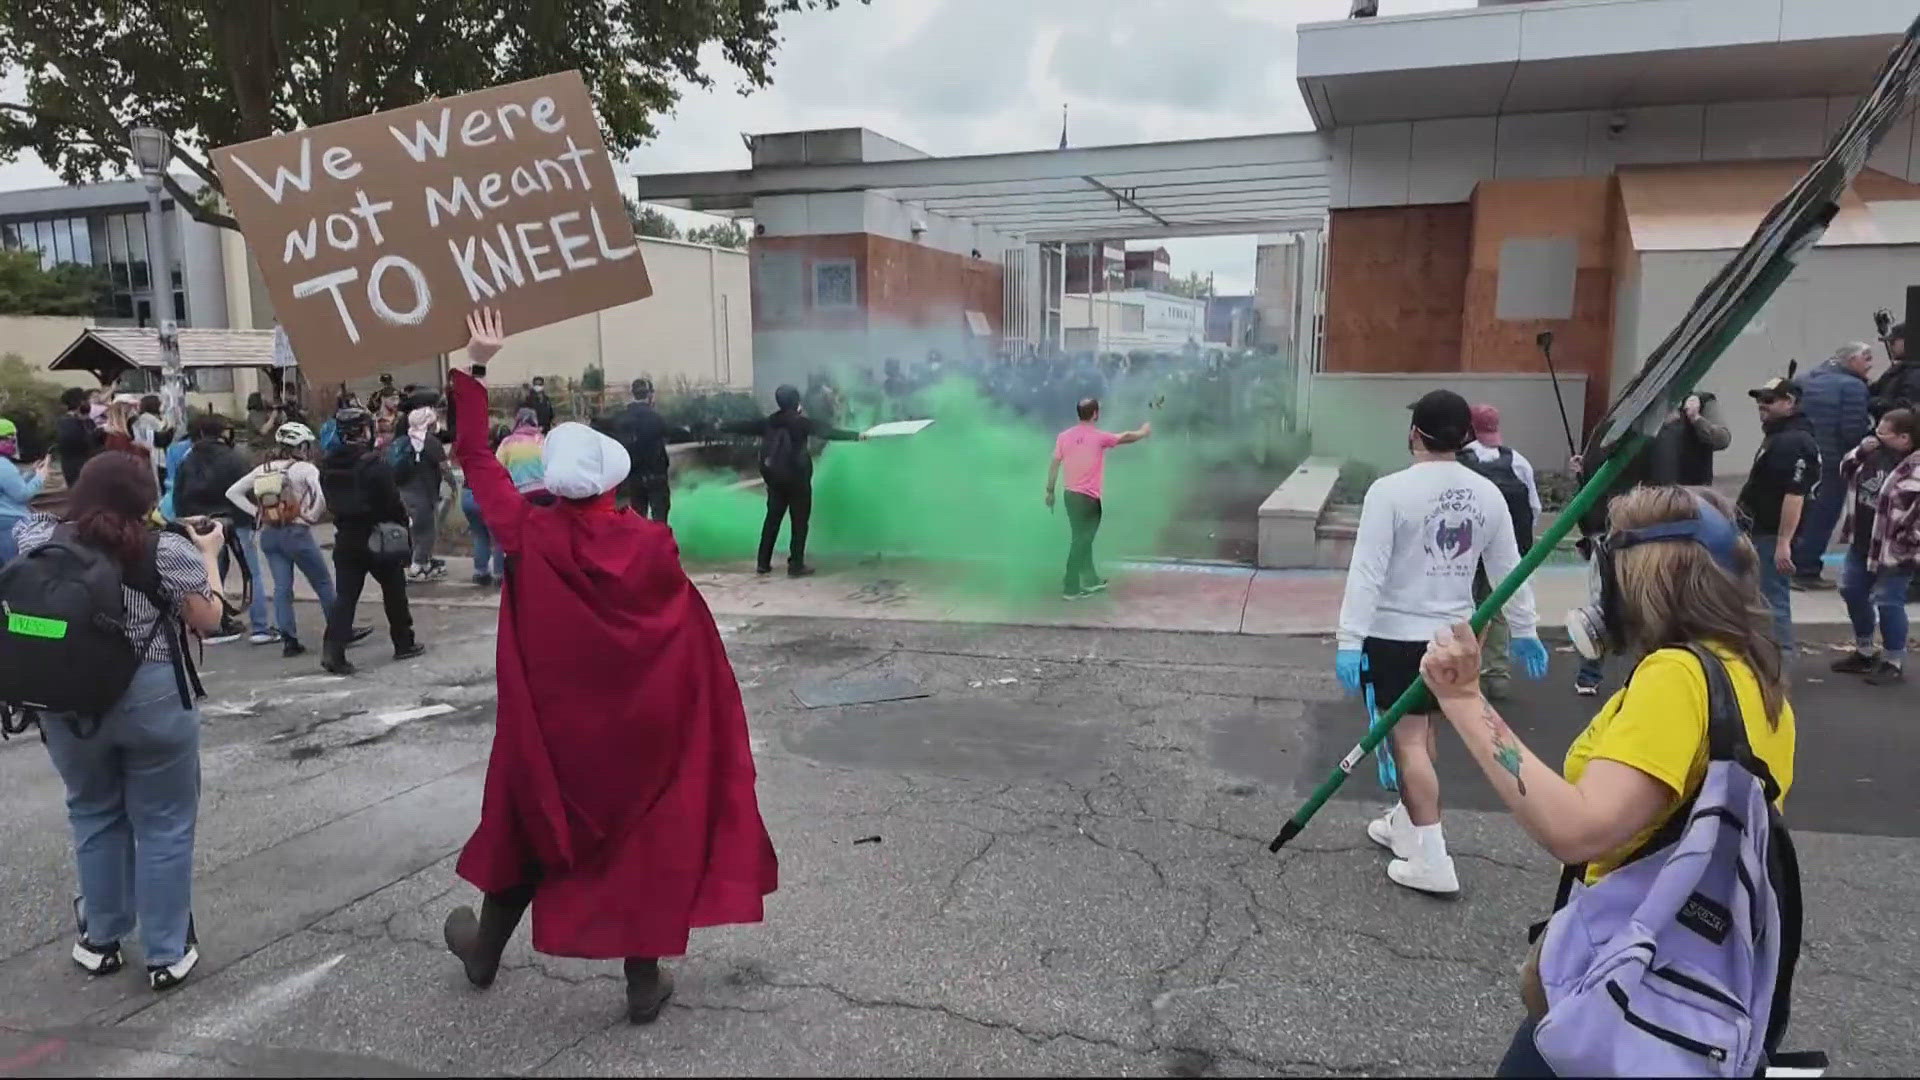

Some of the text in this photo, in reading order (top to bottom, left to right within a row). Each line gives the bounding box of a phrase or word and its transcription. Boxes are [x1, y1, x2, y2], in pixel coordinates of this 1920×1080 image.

[230, 96, 566, 204] We Were
[425, 135, 595, 227] Meant
[293, 201, 639, 345] TO KNEEL
